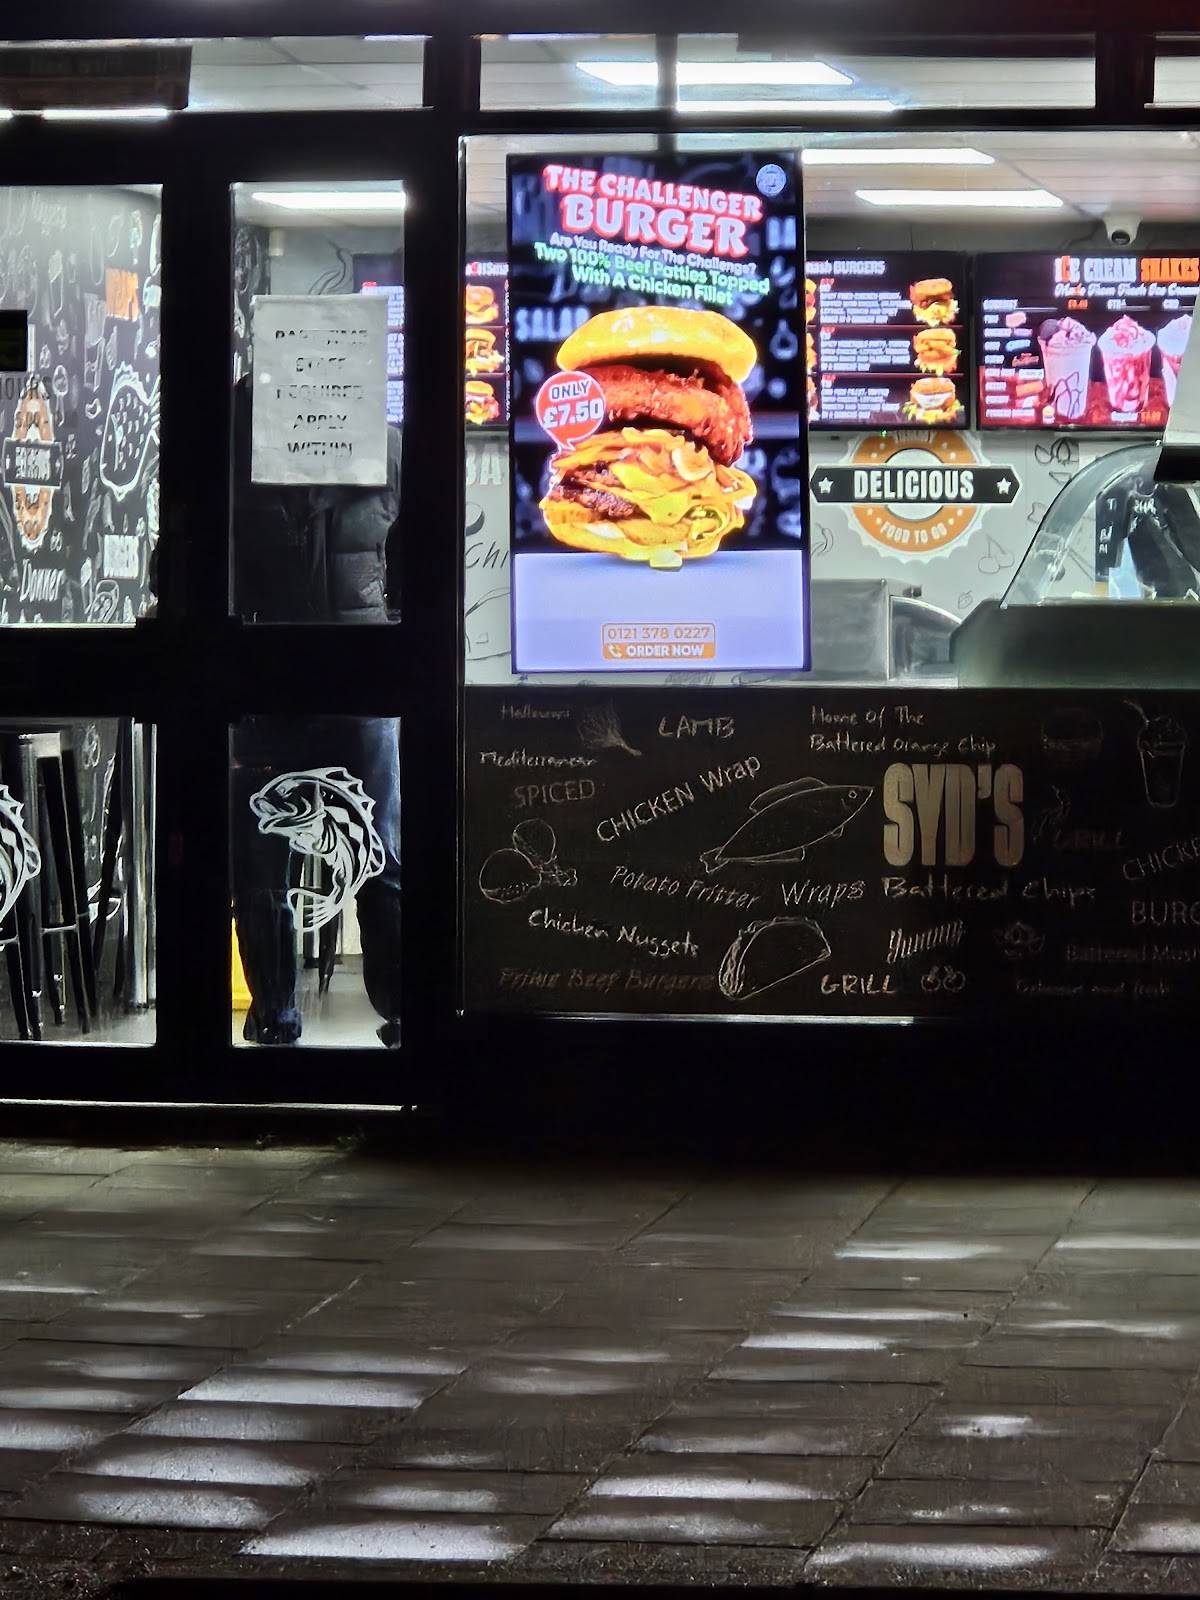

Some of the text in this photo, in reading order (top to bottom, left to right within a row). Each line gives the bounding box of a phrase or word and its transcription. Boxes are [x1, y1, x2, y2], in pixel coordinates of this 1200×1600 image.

[543, 164, 600, 194] THE
[600, 171, 763, 222] CHALLENGER
[562, 193, 749, 258] BURGER
[534, 241, 770, 296] Two 100% Beef Patties Topped
[550, 232, 757, 276] Are You Ready For The Challenge?
[834, 261, 886, 275] BURGERS
[572, 265, 733, 305] With A Chicken Fillet
[1084, 258, 1136, 283] CREAM
[550, 379, 592, 400] ONLY
[543, 399, 604, 429] £7.50
[853, 469, 974, 500] DELICIOUS
[880, 521, 948, 545] FOOD TO GO
[607, 626, 711, 640] 0121 378 0227
[626, 644, 704, 657] ORDER NOW
[657, 715, 735, 739] LAMB
[809, 704, 926, 728] Home Of The
[512, 779, 595, 809] SPICED
[595, 755, 761, 842] CHICKEN Wrap
[882, 762, 1025, 868] SYD'S
[781, 878, 867, 908] Wraps
[528, 907, 609, 939] Chicken
[819, 973, 897, 996] GRILL
